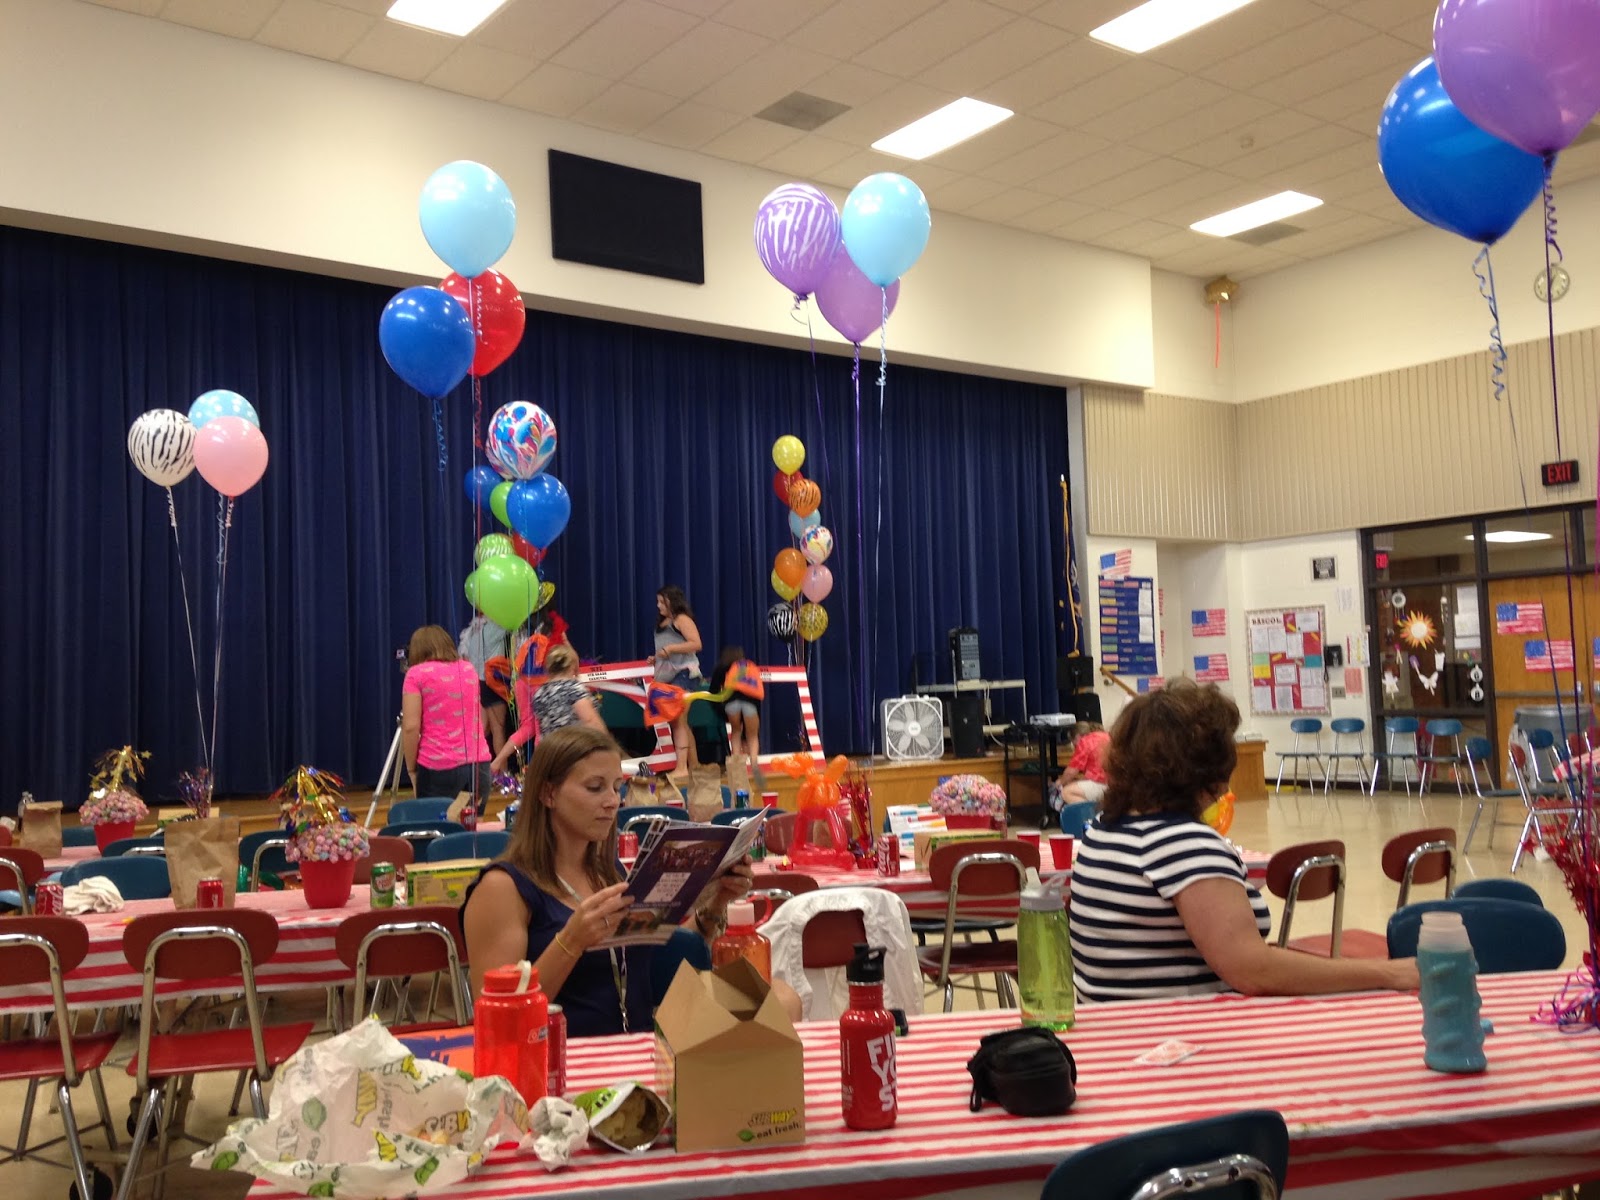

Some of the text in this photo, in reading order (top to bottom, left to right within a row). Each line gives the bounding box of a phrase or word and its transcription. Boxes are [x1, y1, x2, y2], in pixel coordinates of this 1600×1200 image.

[1547, 463, 1573, 484] EXIT
[747, 1107, 798, 1128] SUBWAY
[757, 1128, 772, 1139] eat
